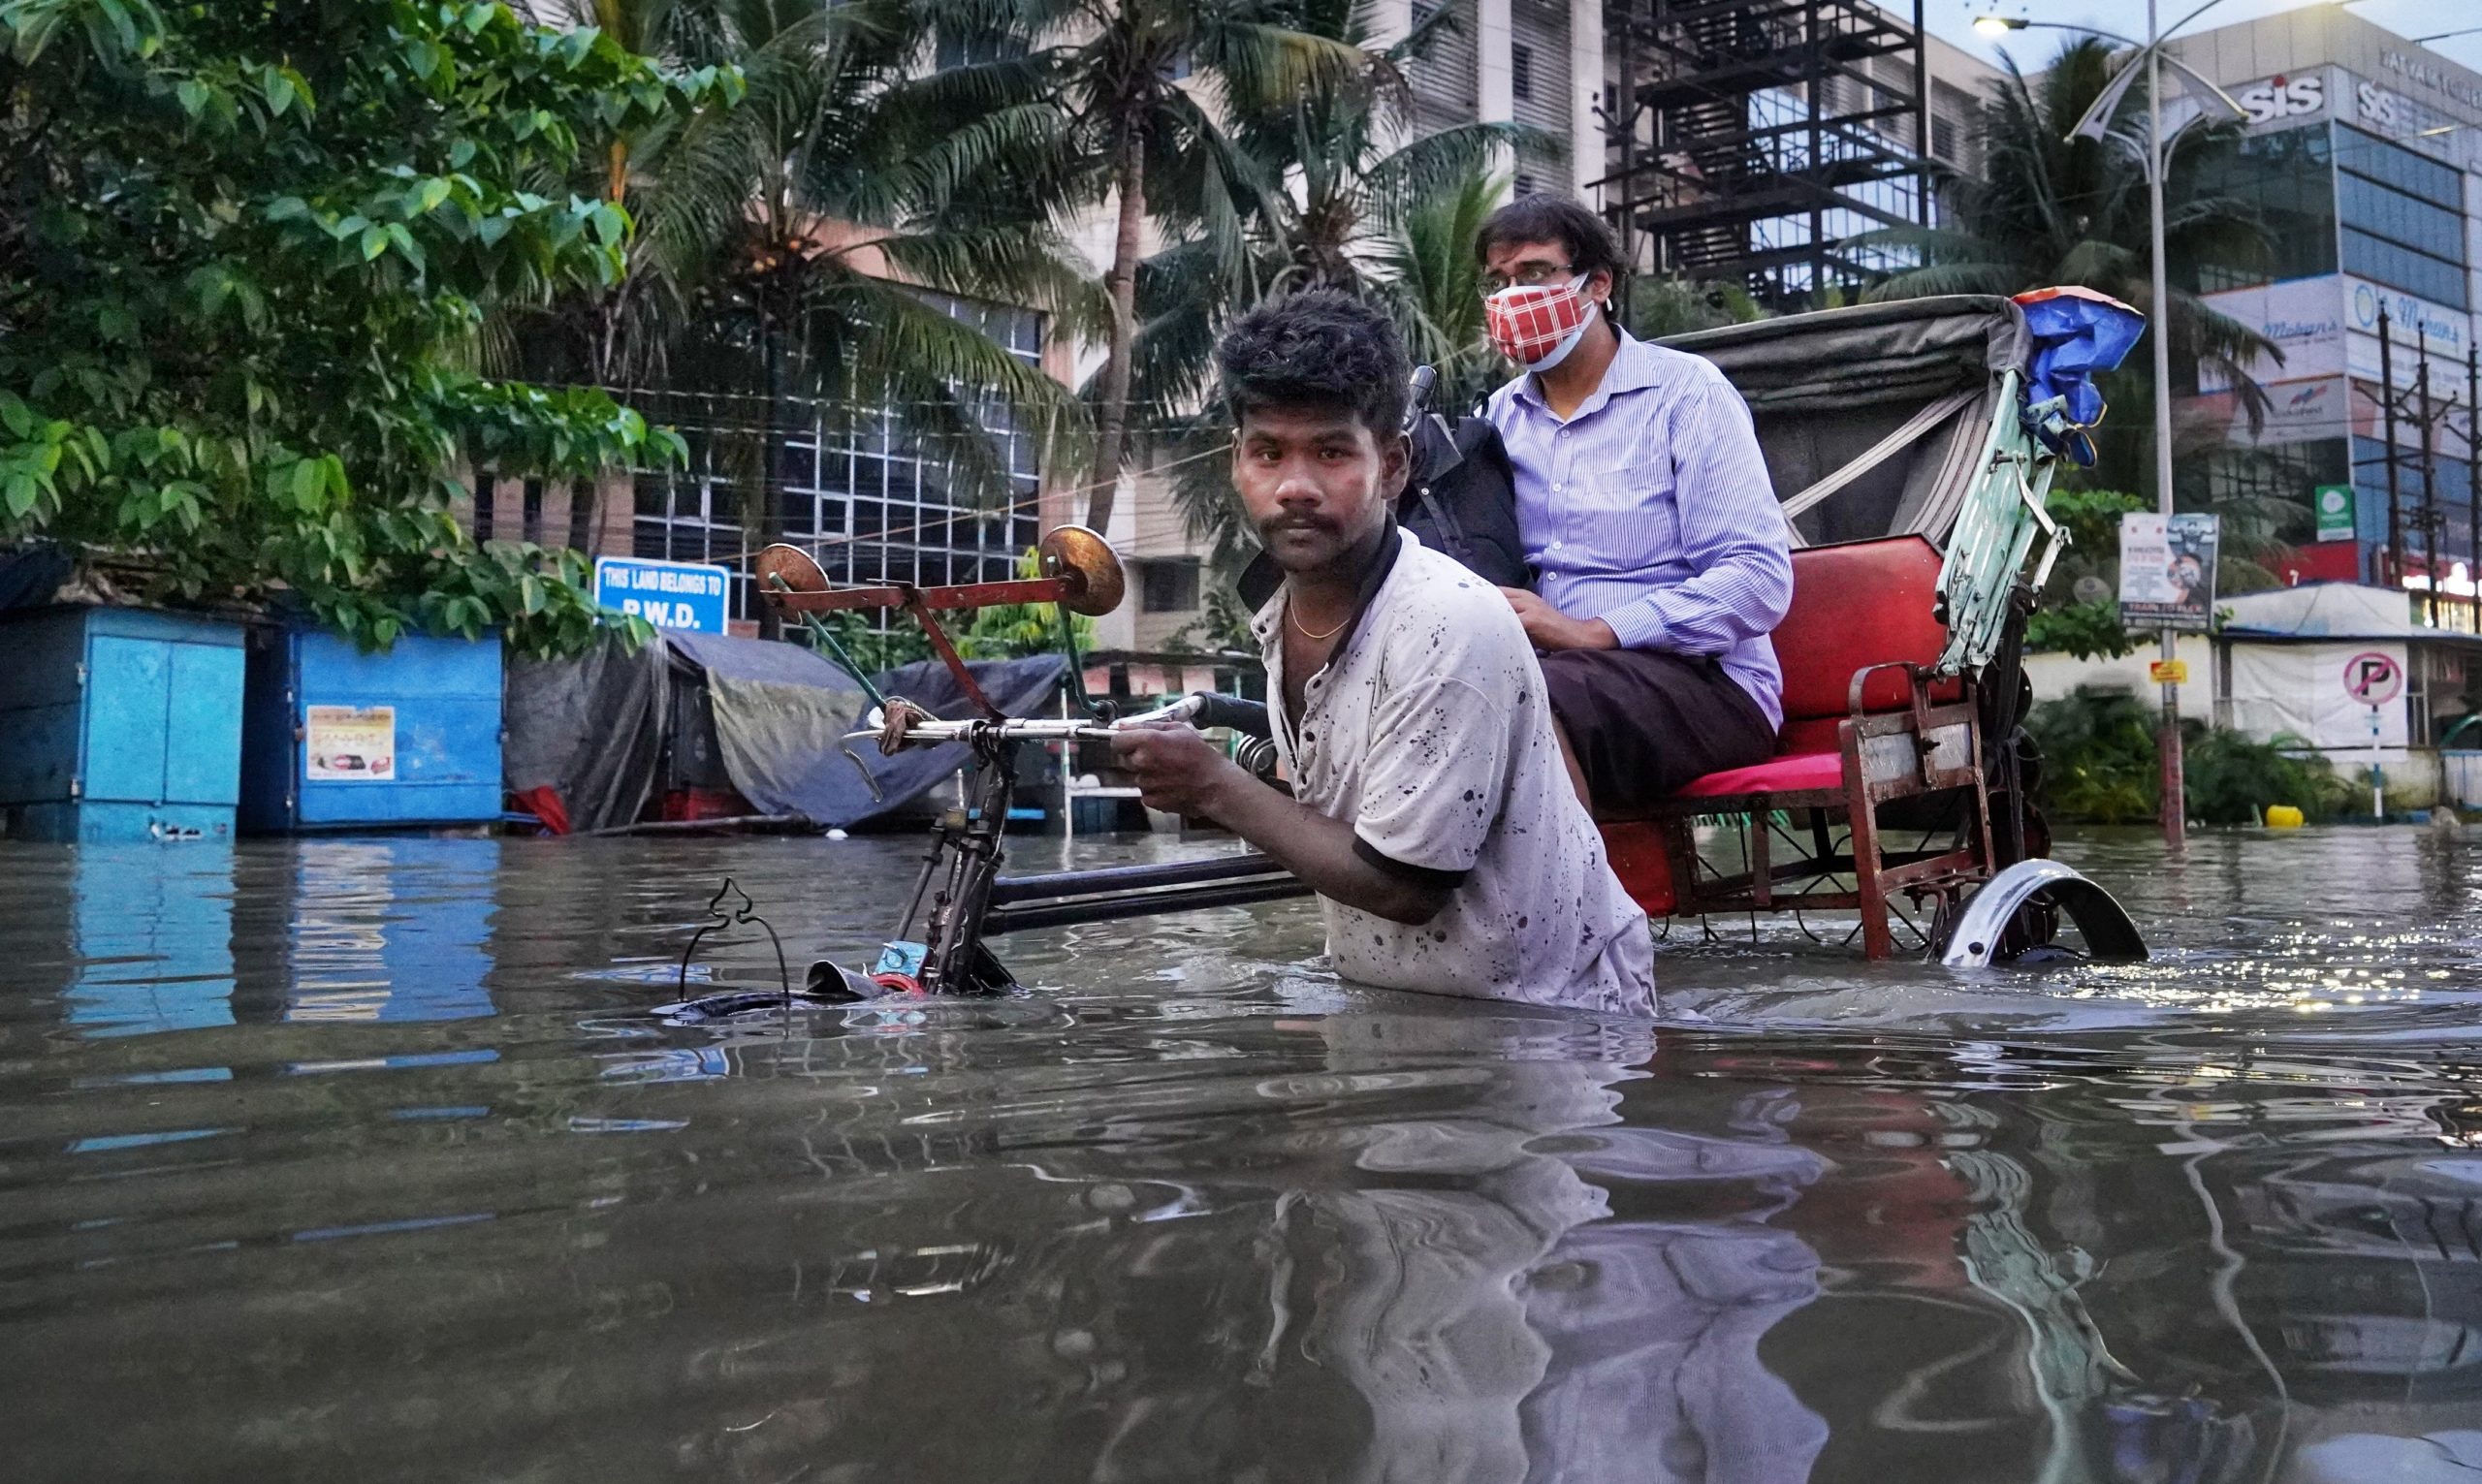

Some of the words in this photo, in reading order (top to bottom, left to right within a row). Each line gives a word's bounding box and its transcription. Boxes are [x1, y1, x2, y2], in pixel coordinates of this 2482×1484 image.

[603, 567, 629, 589] THIS
[631, 569, 659, 591] LAND
[660, 572, 707, 595] BELONGS
[708, 576, 721, 596] TO
[622, 598, 701, 629] PW.D.
